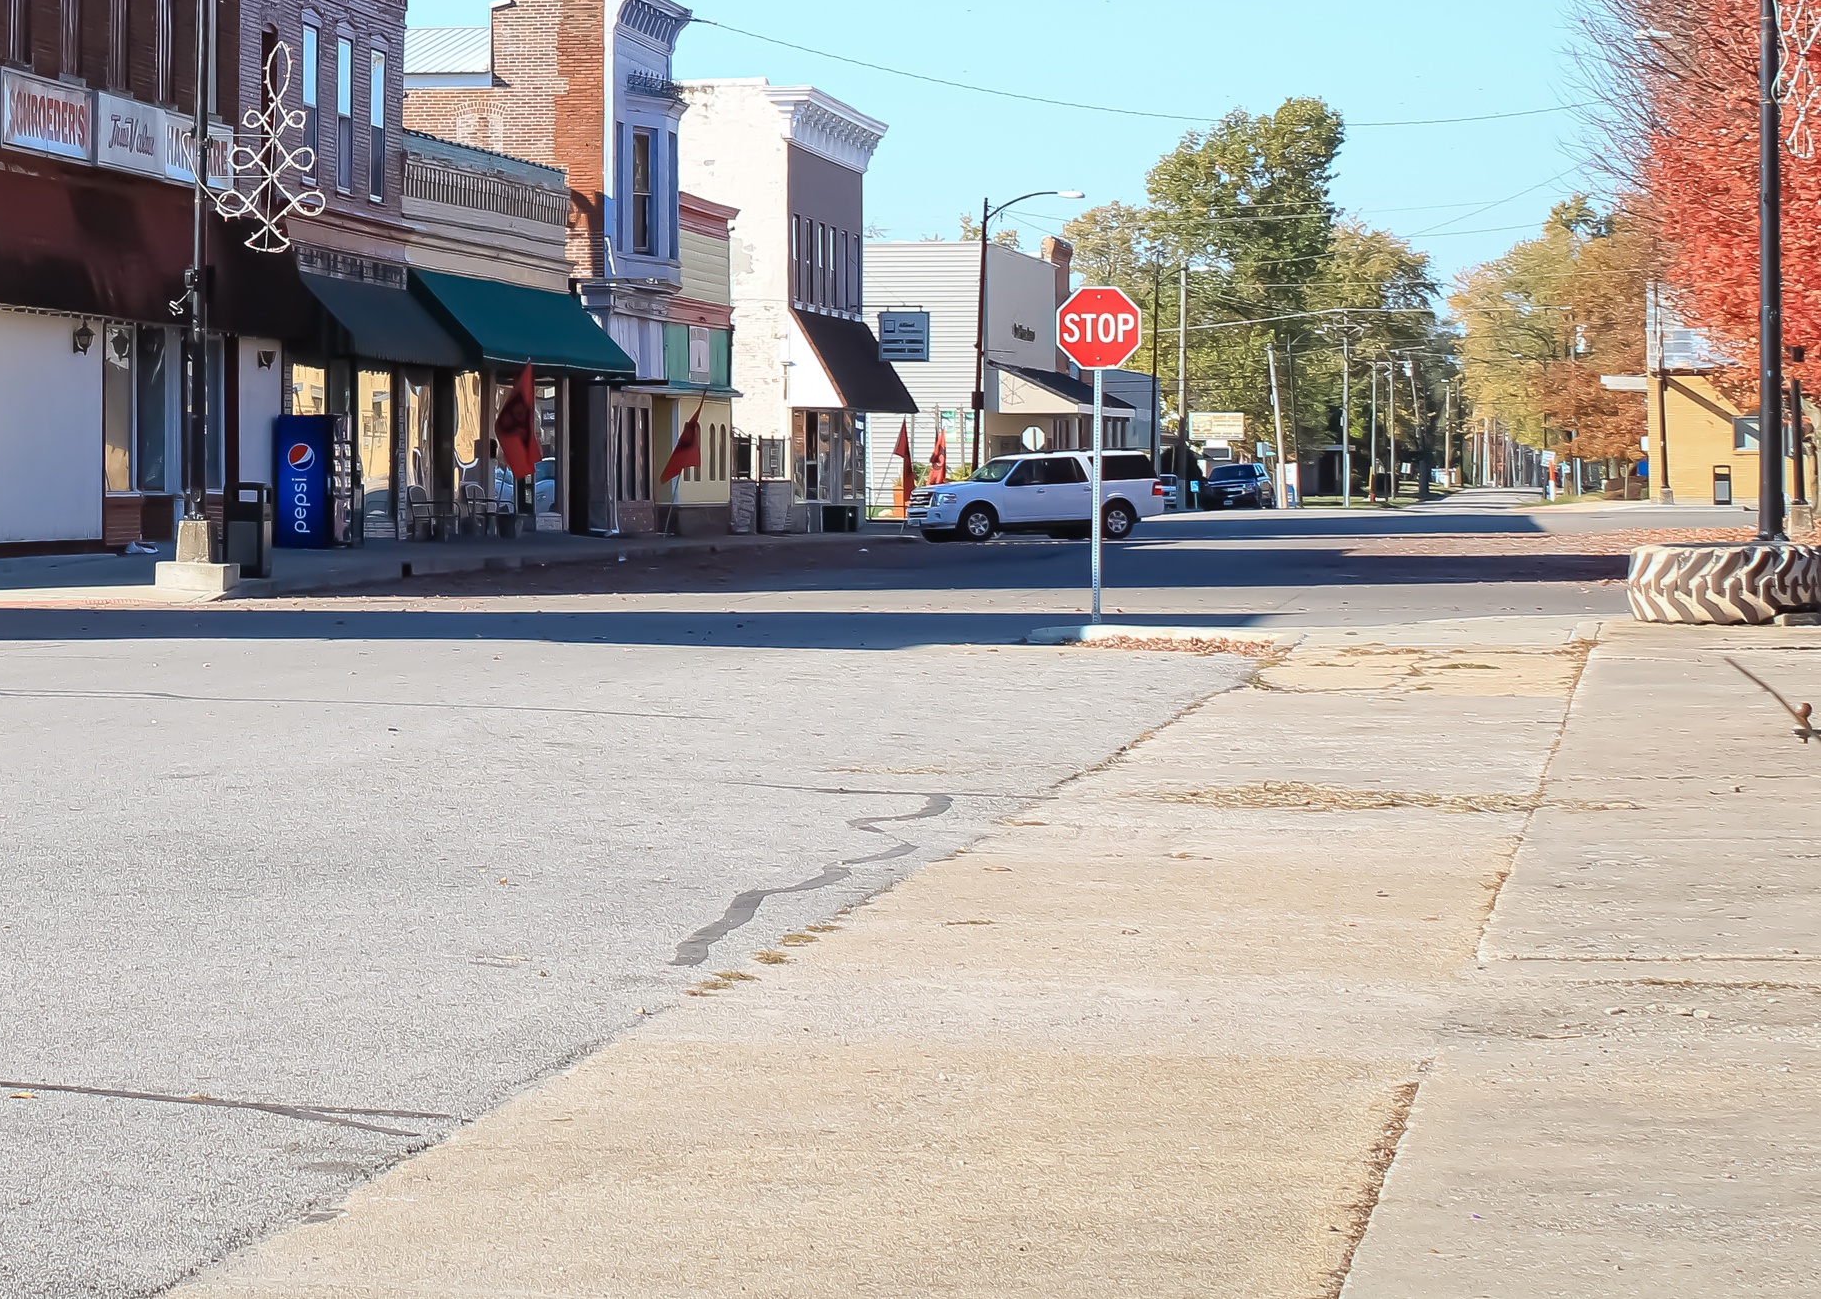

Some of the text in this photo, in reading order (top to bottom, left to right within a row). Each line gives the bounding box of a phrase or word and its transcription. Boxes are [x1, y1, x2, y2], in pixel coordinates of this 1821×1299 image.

[166, 124, 228, 177] HARDARE
[1062, 312, 1135, 344] STOP
[291, 477, 311, 533] pepsi
